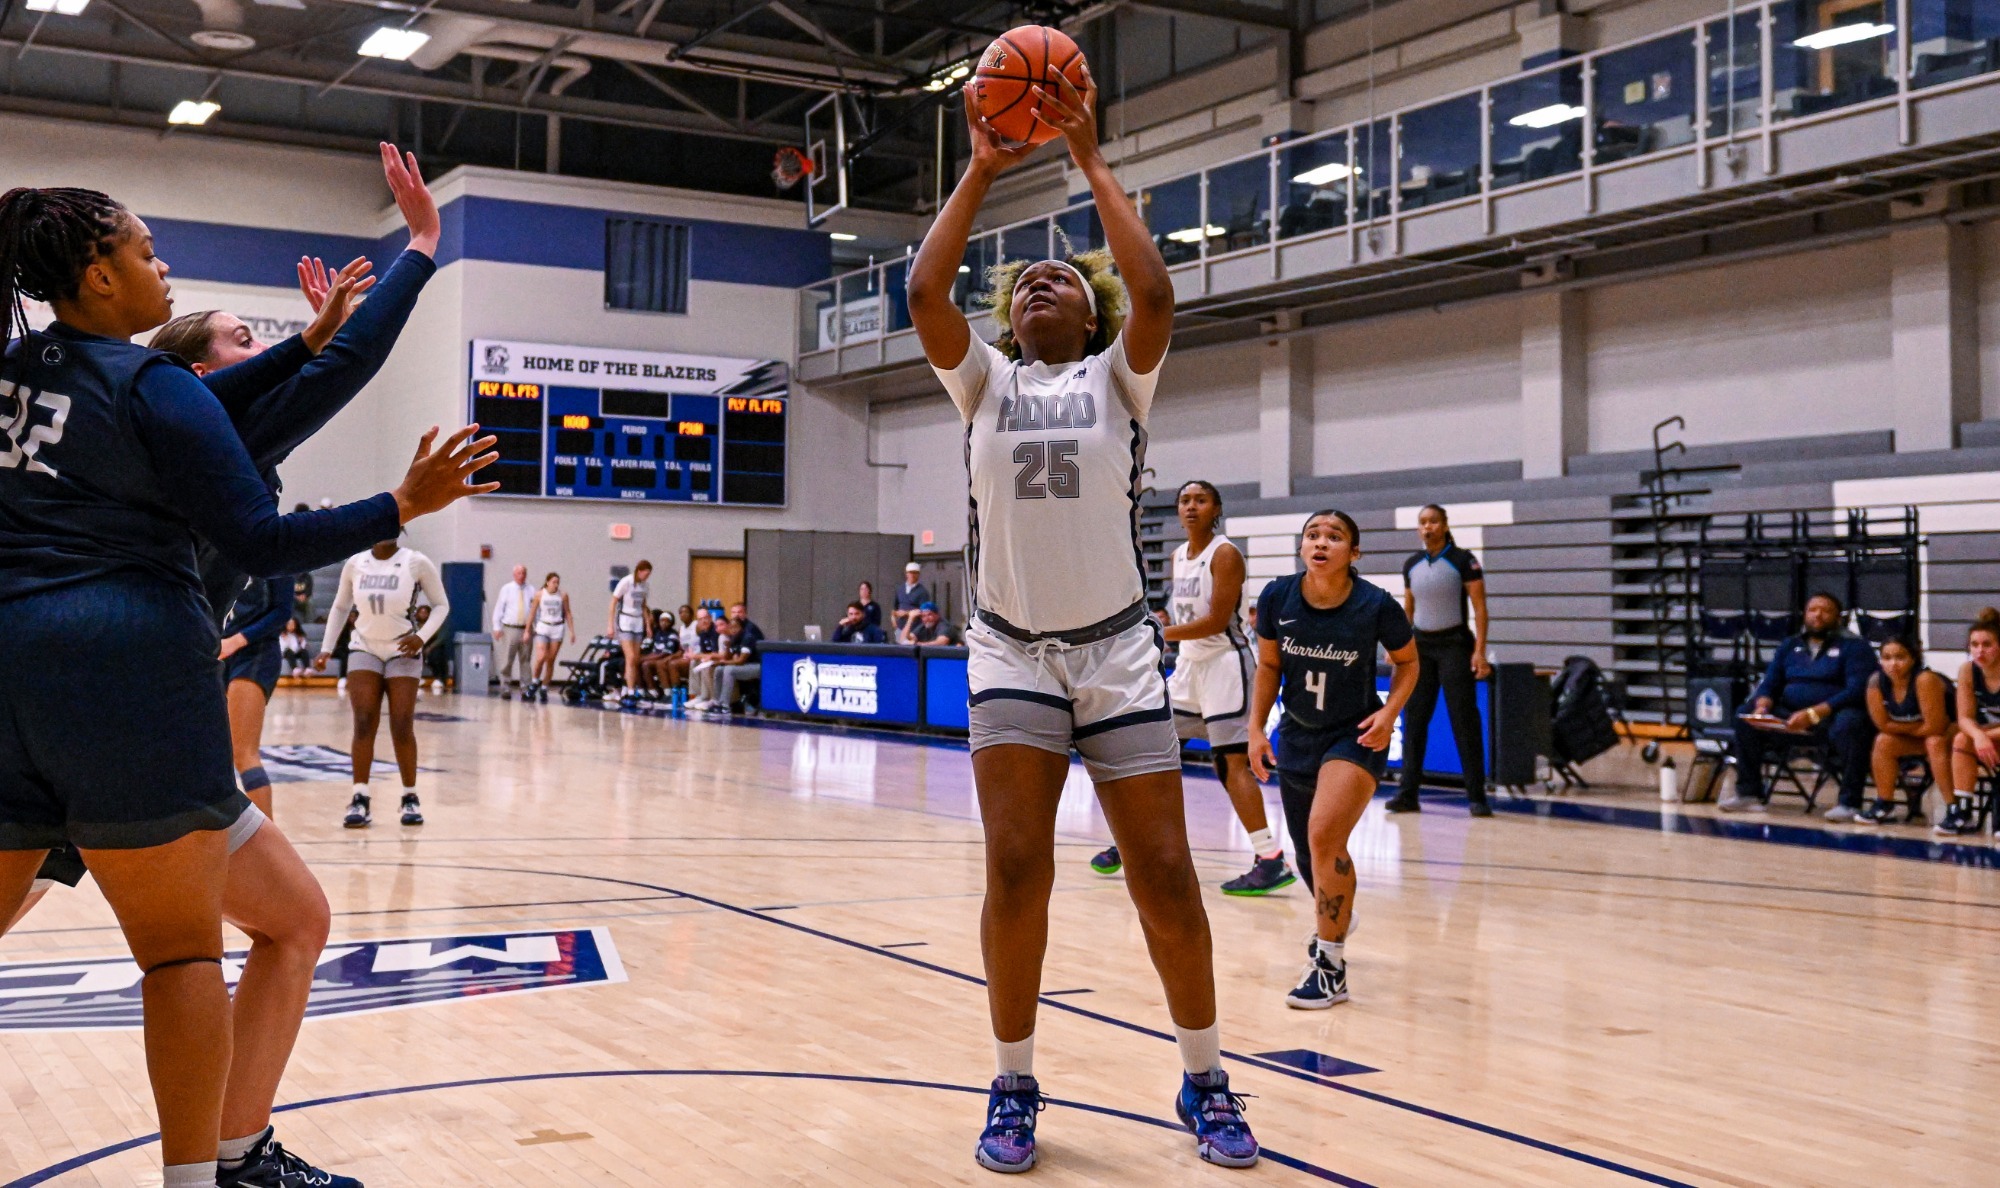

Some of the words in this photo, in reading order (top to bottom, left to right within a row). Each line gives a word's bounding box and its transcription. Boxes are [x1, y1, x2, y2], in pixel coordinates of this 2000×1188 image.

[523, 356, 574, 372] HOME
[579, 360, 600, 373] OF
[603, 361, 638, 376] THE
[642, 364, 717, 381] BLAZERS
[518, 384, 540, 399] PTS
[763, 399, 783, 415] PTS
[996, 391, 1097, 432] HOOD
[622, 425, 648, 435] PERIOD
[554, 456, 578, 466] FOULS
[584, 457, 604, 467] T.O.L.
[611, 459, 638, 469] PLAYER
[639, 460, 657, 470] FOUL
[689, 463, 712, 472] FOULS
[1013, 440, 1080, 499] 25
[555, 487, 574, 497] WON
[621, 490, 646, 499] MATCH
[691, 493, 709, 502] WON
[359, 574, 399, 590] HOOD
[368, 593, 385, 615] 11
[1281, 636, 1360, 667] Harrisburg
[818, 687, 878, 715] BLAZERS
[1305, 670, 1327, 711] 4
